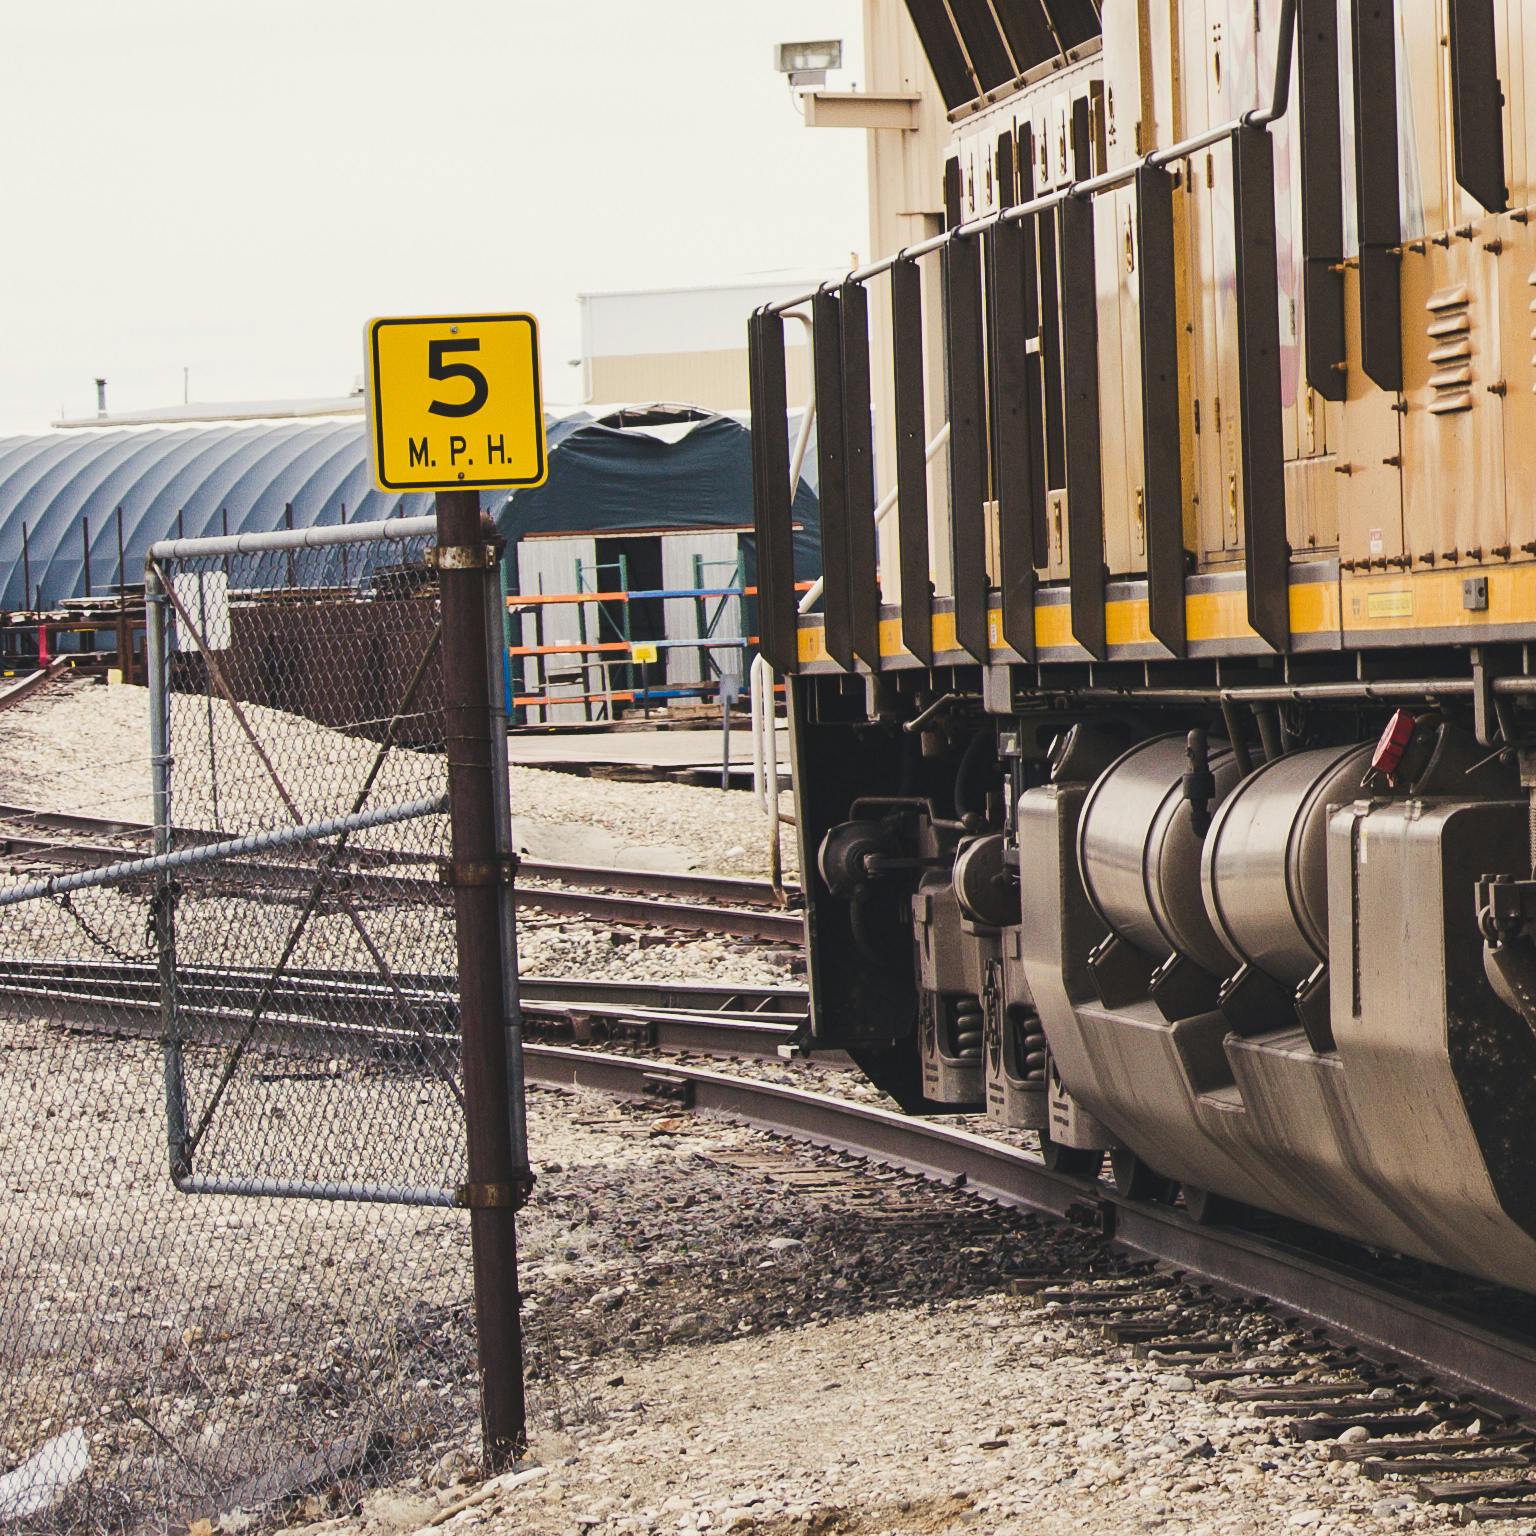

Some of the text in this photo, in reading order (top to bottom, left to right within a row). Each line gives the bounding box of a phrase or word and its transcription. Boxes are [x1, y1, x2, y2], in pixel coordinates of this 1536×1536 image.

[428, 337, 489, 418] 5
[408, 433, 513, 468] M. P. H.
